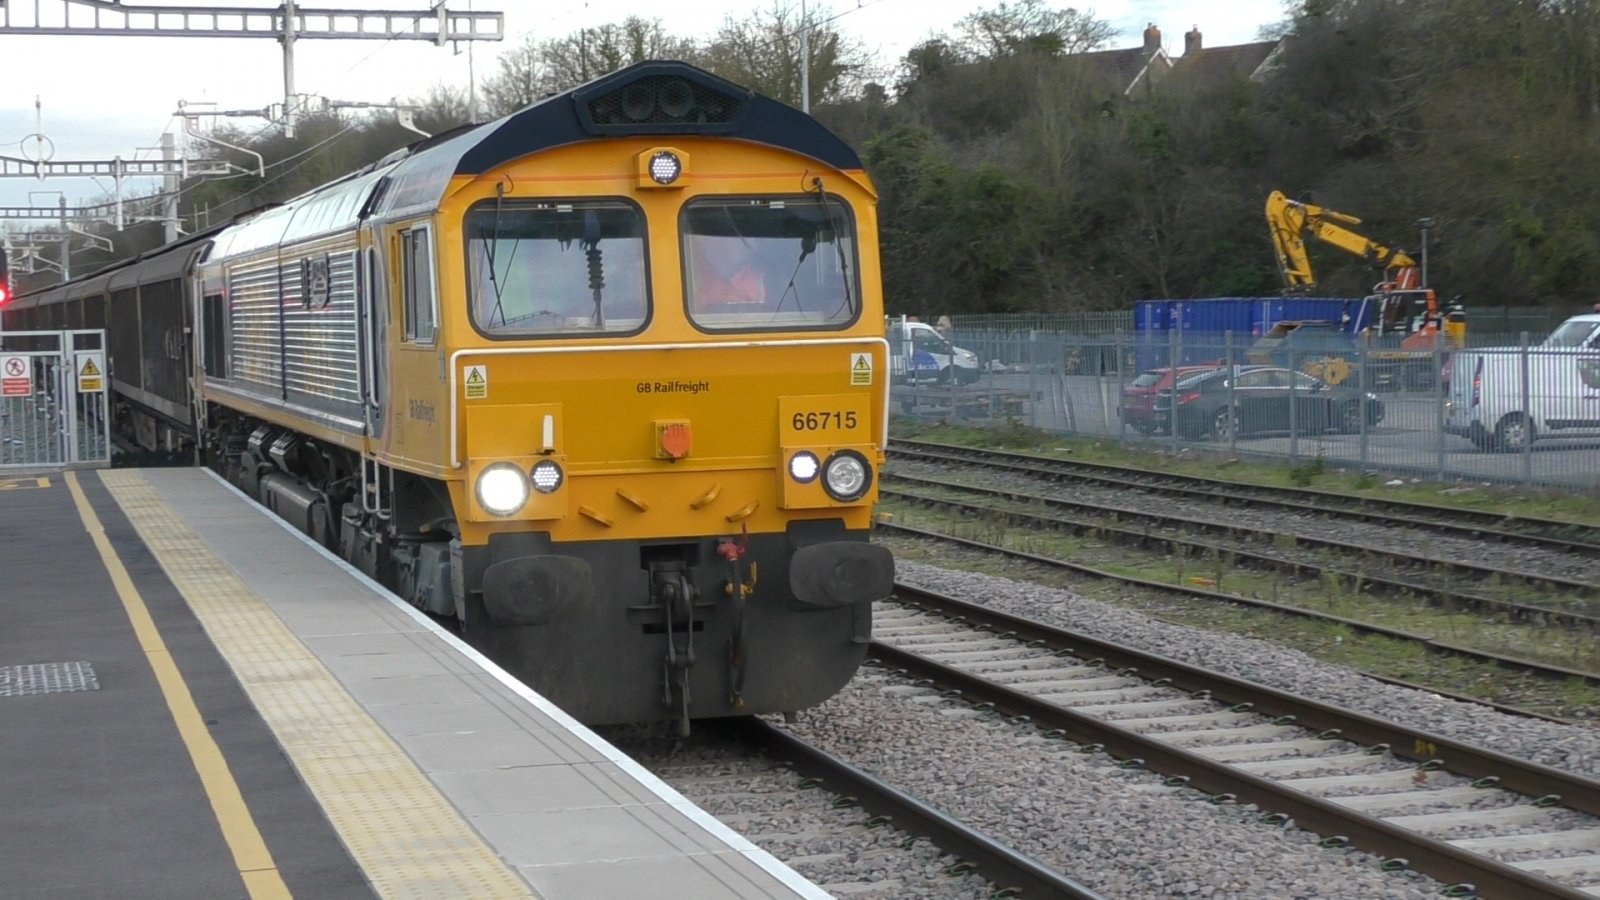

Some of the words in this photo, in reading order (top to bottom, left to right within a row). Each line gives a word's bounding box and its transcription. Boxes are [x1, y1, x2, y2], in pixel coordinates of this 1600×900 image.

[637, 382, 651, 393] GB
[654, 381, 710, 394] Railfreight
[792, 411, 857, 431] 66715
